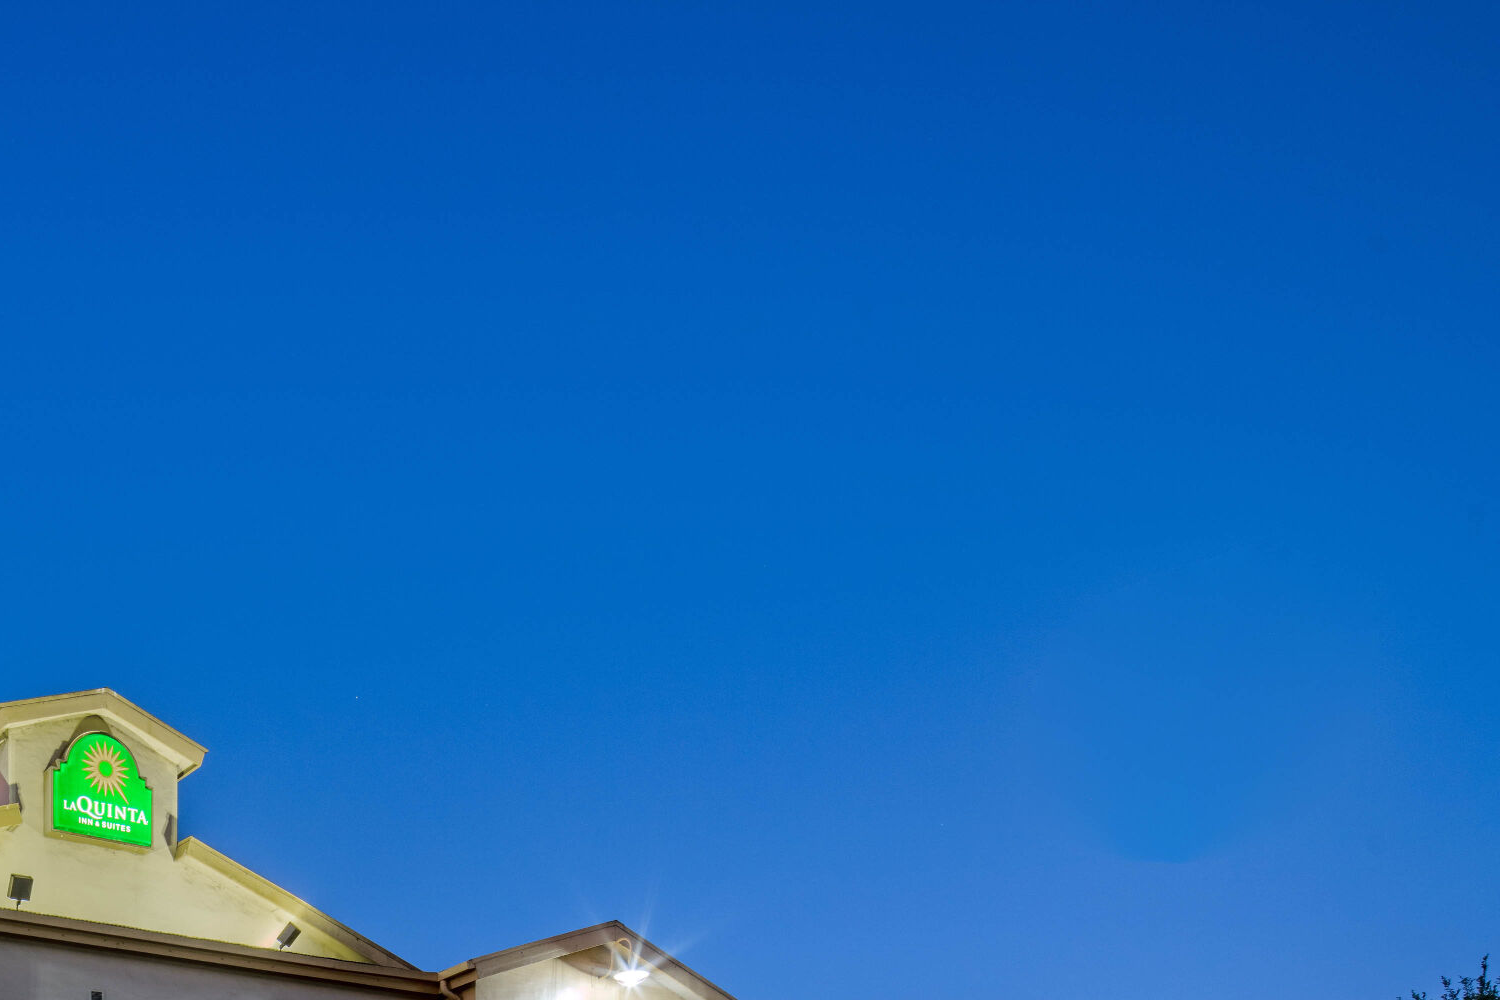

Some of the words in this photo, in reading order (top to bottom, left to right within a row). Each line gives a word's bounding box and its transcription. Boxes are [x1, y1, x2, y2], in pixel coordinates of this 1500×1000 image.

[78, 816, 94, 826] INN
[94, 820, 100, 828] &
[101, 821, 132, 833] SUITES
